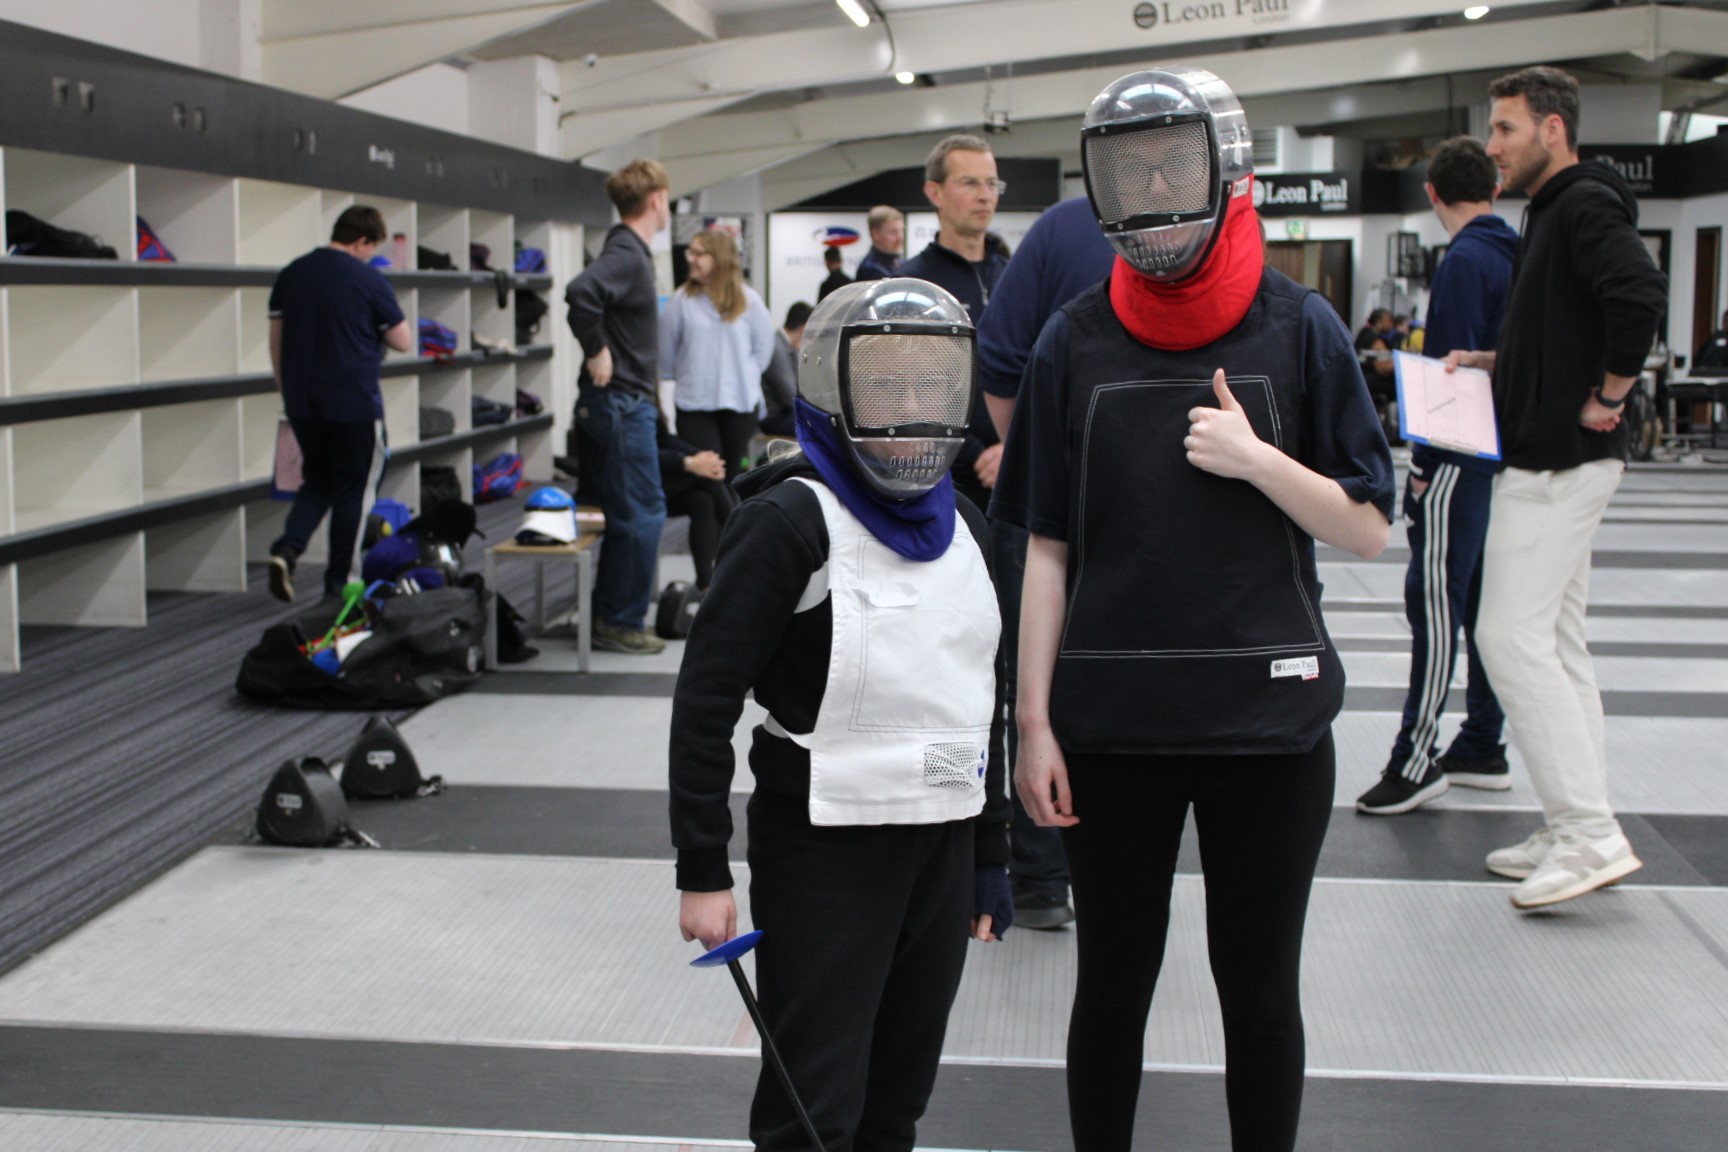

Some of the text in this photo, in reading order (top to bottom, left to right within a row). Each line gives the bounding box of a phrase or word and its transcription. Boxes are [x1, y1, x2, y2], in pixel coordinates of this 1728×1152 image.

[1162, 3, 1225, 24] Leon
[1265, 181, 1308, 204] Leon
[1309, 178, 1348, 203] Paul
[1283, 662, 1301, 671] Leon
[1302, 660, 1317, 669] Paul
